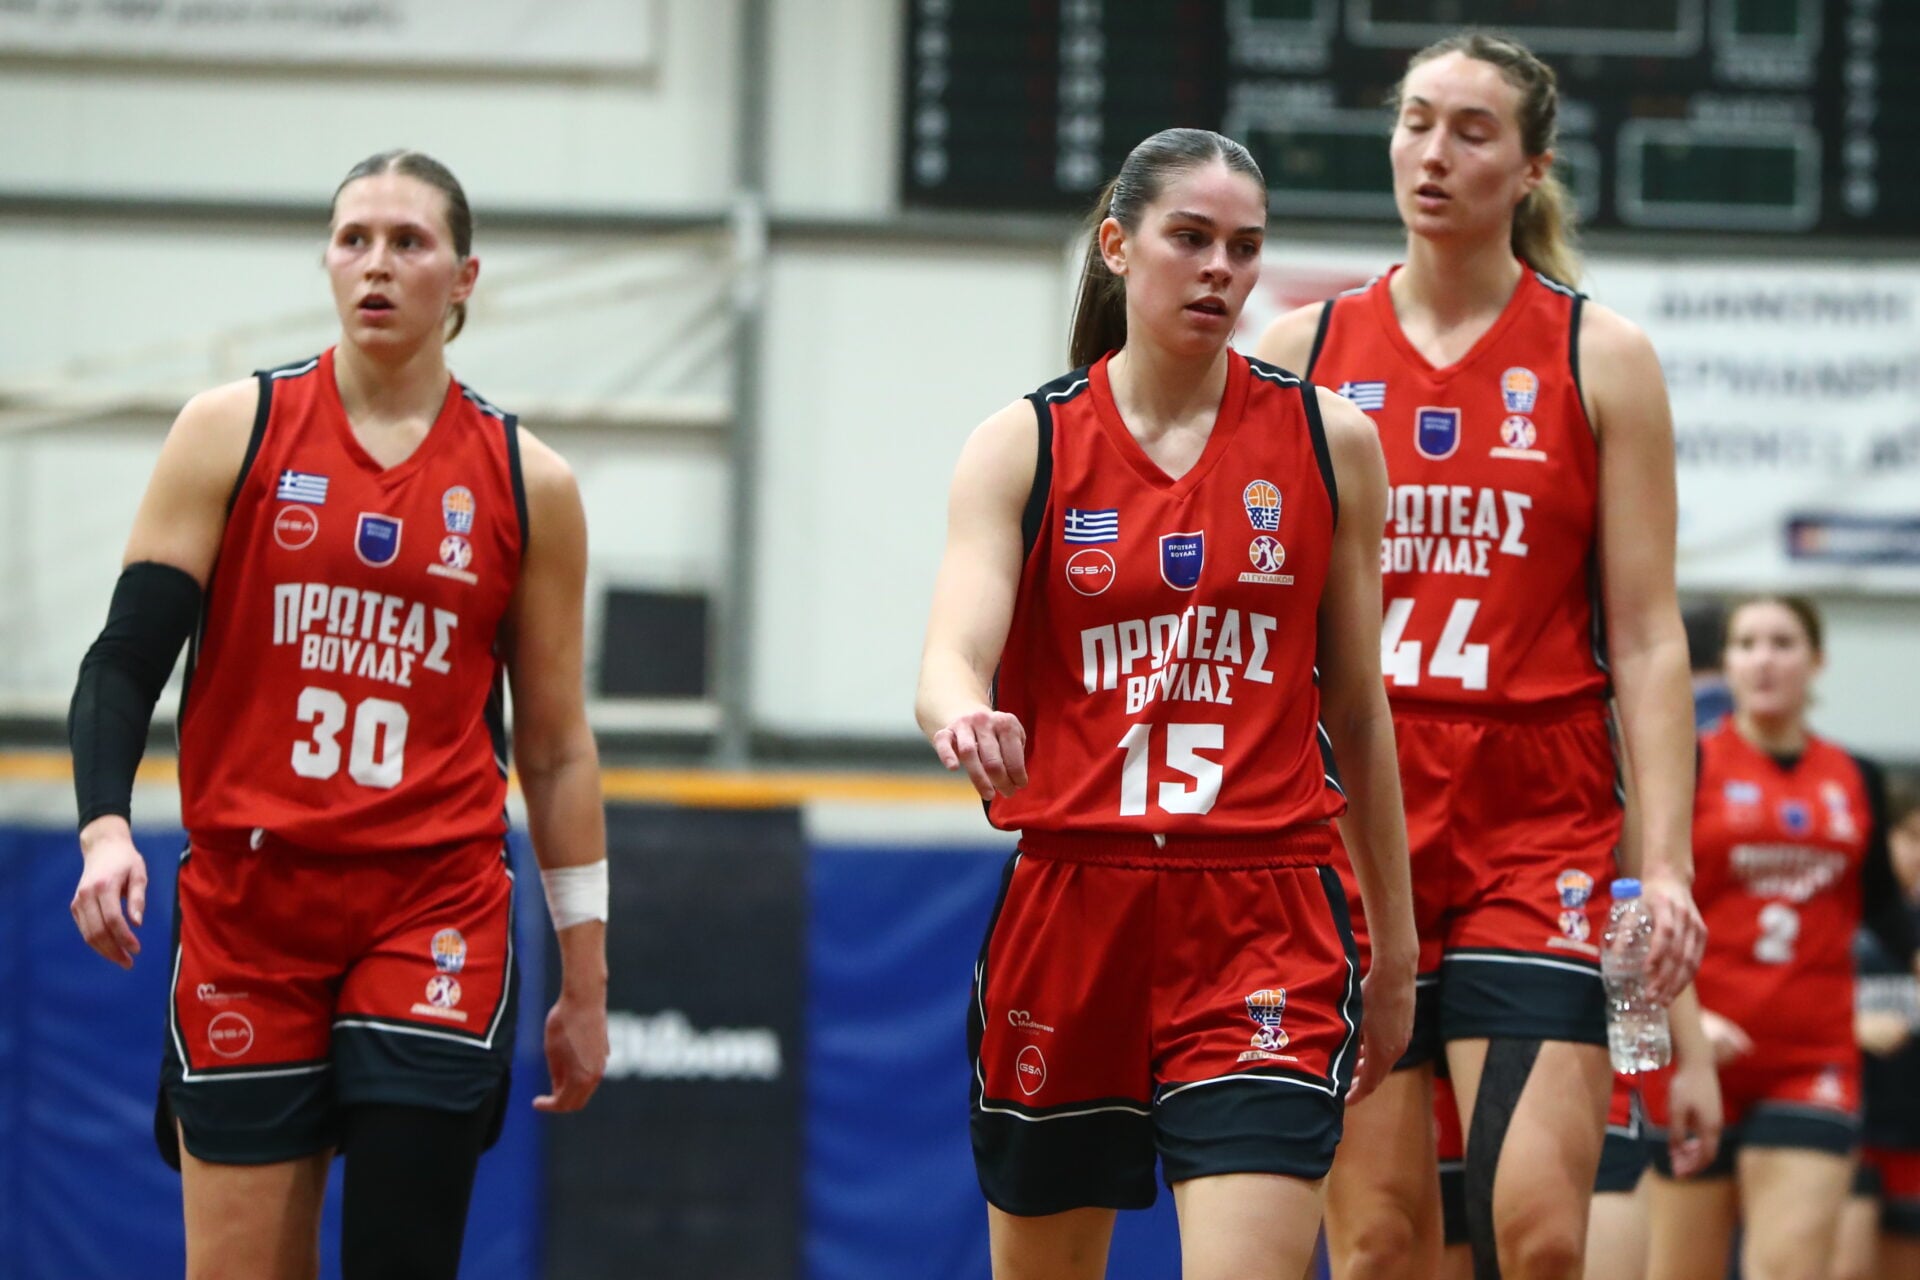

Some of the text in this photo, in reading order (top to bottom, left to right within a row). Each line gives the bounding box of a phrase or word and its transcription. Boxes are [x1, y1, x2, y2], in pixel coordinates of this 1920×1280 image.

[1385, 484, 1532, 557] ΩΤΕΑΣ
[1070, 564, 1111, 575] GSA
[1380, 536, 1491, 578] ΒΟΥΛΑΣ
[273, 582, 459, 675] ΠΡΩΤΕΑΣ
[300, 633, 416, 688] ΒΟΥΛΑΣ
[1080, 604, 1277, 695] ΠΡΩΤΕΑΣ
[1381, 598, 1489, 691] 44
[1125, 663, 1234, 715] ΒΟΥΛΑΣ
[291, 686, 409, 789] 30
[1117, 722, 1225, 817] 15
[1754, 903, 1801, 964] 2
[1020, 1063, 1042, 1076] GSA
